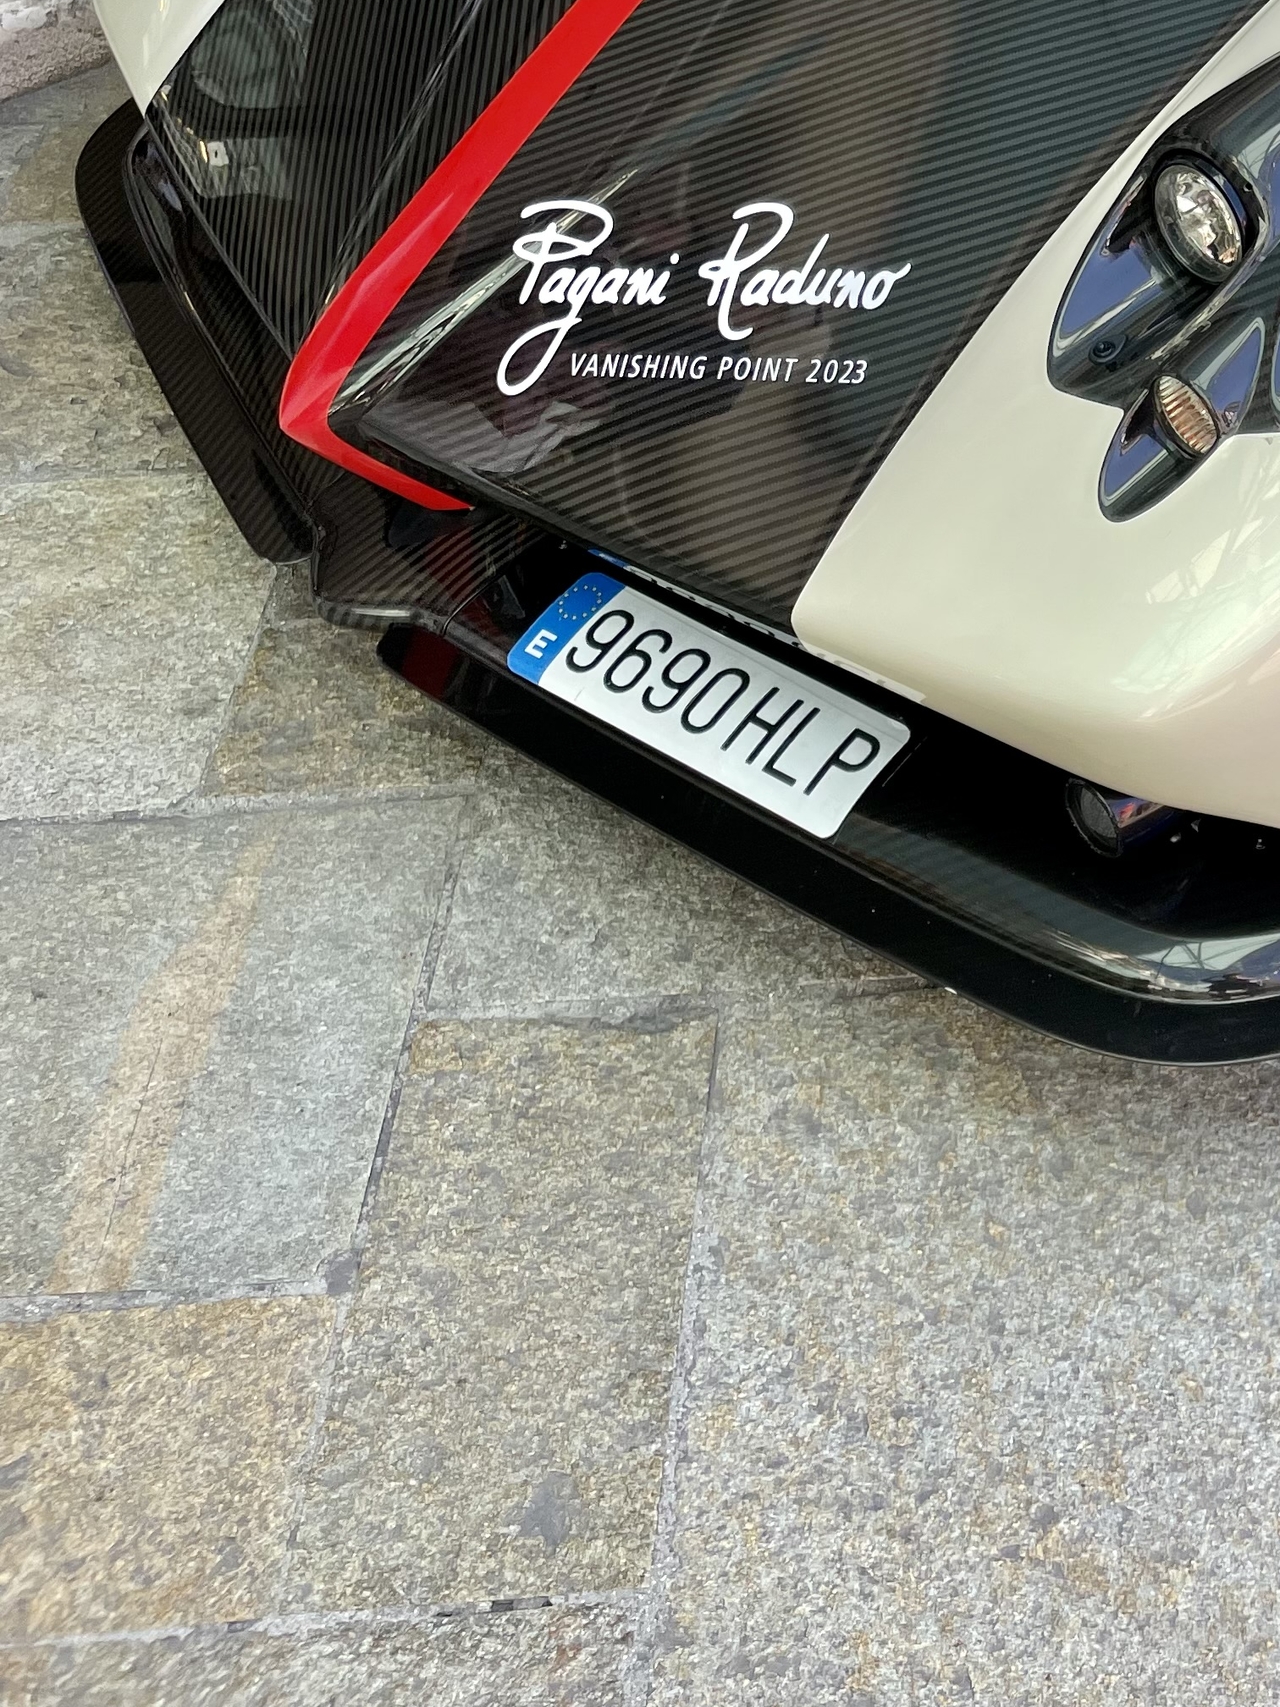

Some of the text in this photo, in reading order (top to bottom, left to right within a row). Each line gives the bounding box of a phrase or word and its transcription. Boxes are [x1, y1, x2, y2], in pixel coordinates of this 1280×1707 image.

[497, 201, 912, 396] Pagani Raduno
[570, 352, 868, 384] VANISHING POINT 2023
[524, 629, 558, 659] E
